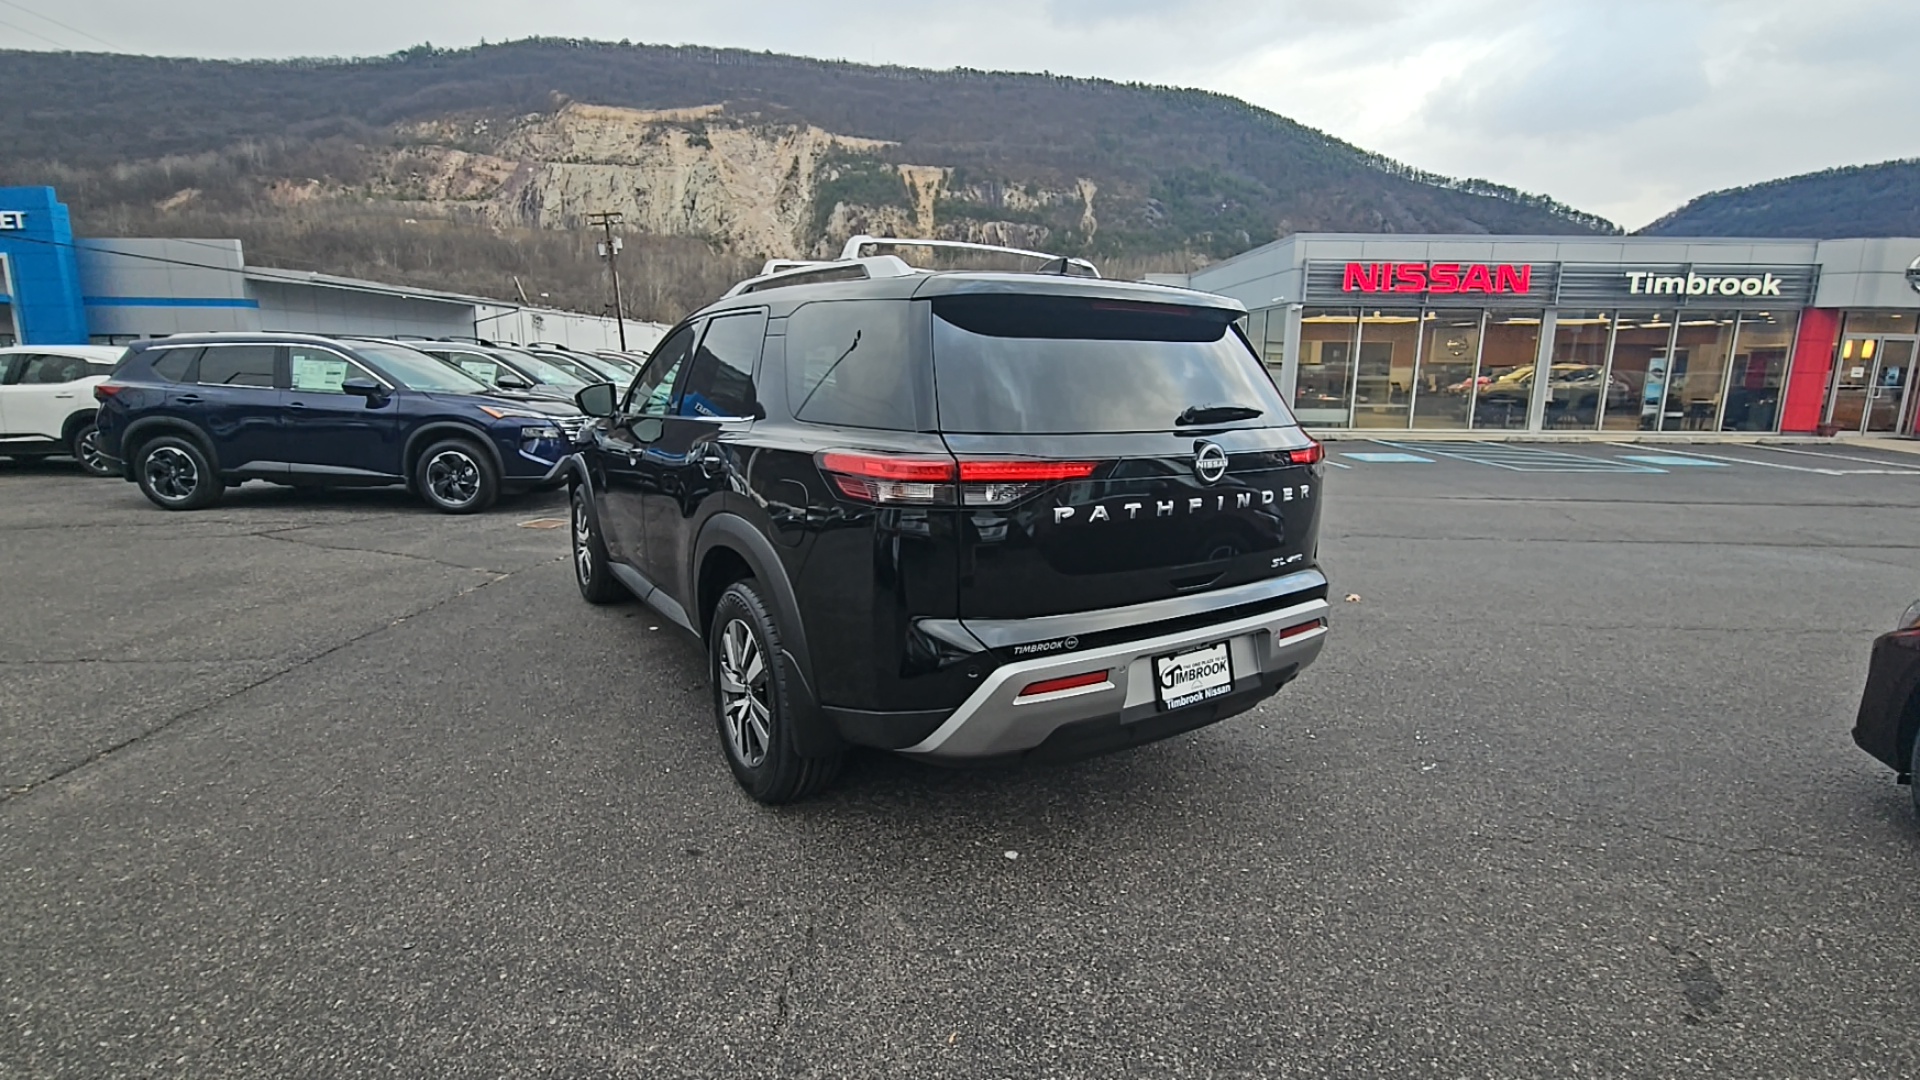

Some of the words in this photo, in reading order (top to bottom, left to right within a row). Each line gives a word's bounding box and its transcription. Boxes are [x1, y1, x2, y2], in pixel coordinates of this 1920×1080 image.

[1342, 262, 1532, 293] NISSAN
[1625, 271, 1782, 296] Timbrook
[1196, 457, 1229, 469] NISSAN
[1053, 484, 1312, 524] PATHFINDER
[1014, 640, 1063, 655] TIMBROOK
[1161, 660, 1227, 689] TIMBROOK
[1166, 691, 1203, 710] Timbrook
[1204, 684, 1231, 698] Nissan
